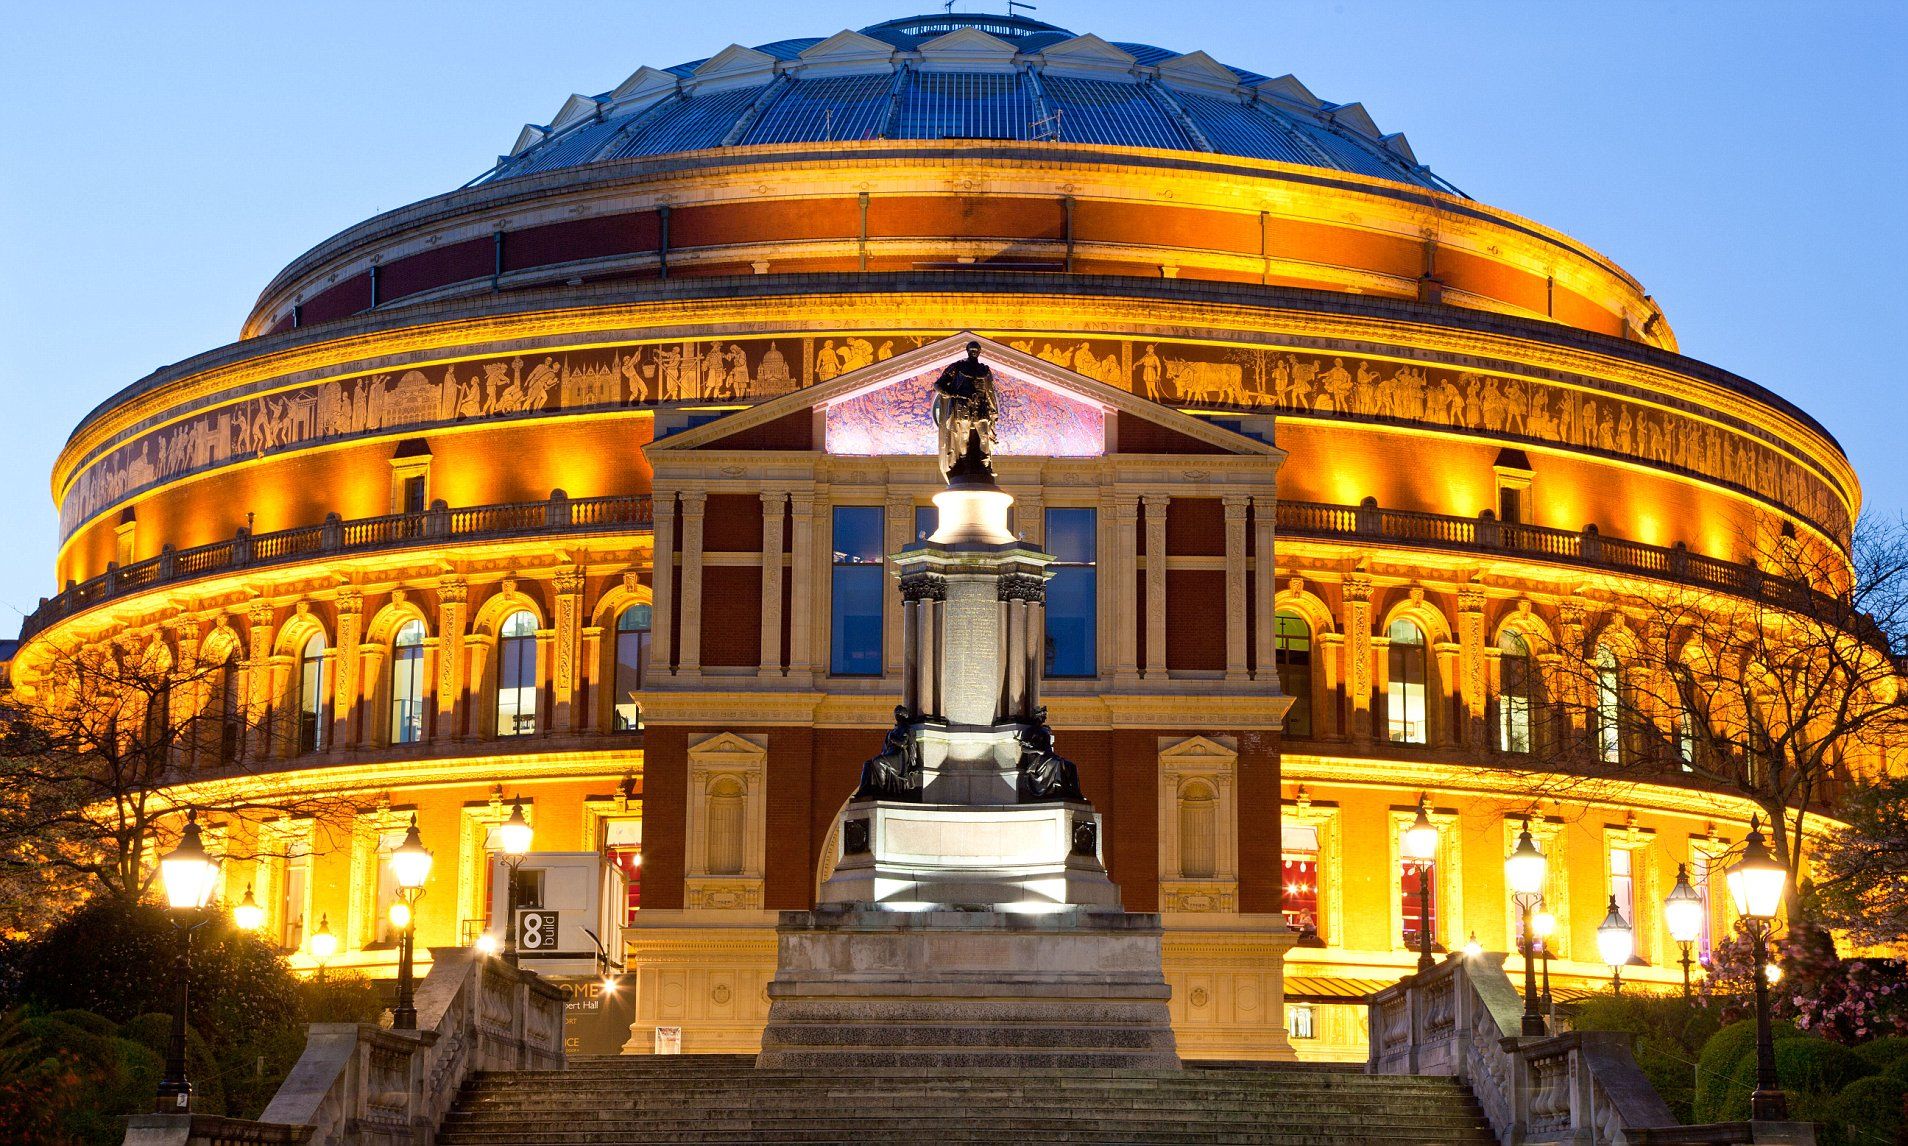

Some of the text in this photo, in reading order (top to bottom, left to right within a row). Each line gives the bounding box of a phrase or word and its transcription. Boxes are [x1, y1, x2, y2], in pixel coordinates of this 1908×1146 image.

[515, 335, 551, 348] QUEEN
[574, 330, 626, 342] VICTORIA
[834, 319, 859, 329] DAY
[1084, 320, 1109, 331] AND
[1171, 326, 1197, 337] WAS
[524, 913, 542, 948] 8
[542, 916, 555, 946] build
[583, 1001, 599, 1009] Hall
